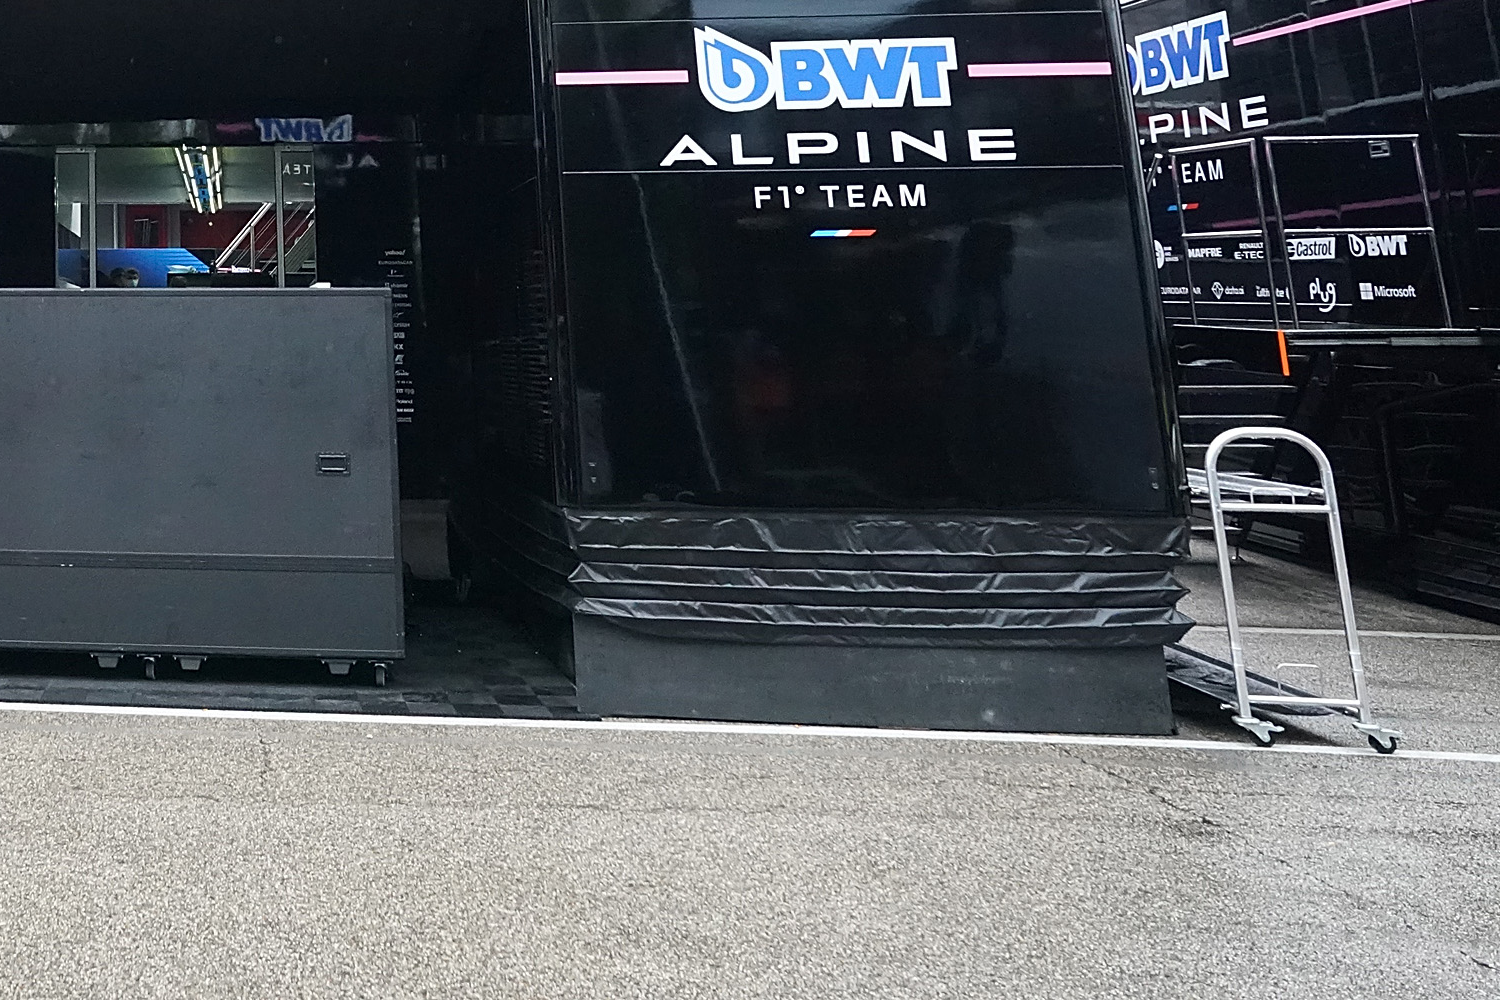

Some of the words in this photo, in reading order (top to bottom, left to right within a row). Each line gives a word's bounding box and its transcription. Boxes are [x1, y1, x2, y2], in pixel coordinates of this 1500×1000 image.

[1135, 10, 1230, 96] BWT
[772, 37, 957, 110] BWT
[1140, 95, 1269, 145] PINE
[660, 129, 1017, 166] ALPINE
[1168, 159, 1224, 184] EAM
[819, 184, 927, 208] TEAM
[1234, 250, 1264, 260] E-TEC
[1296, 240, 1332, 257] Castrol
[1365, 234, 1408, 257] BWT
[1309, 277, 1336, 313] plug
[1374, 285, 1417, 298] Microsoft
